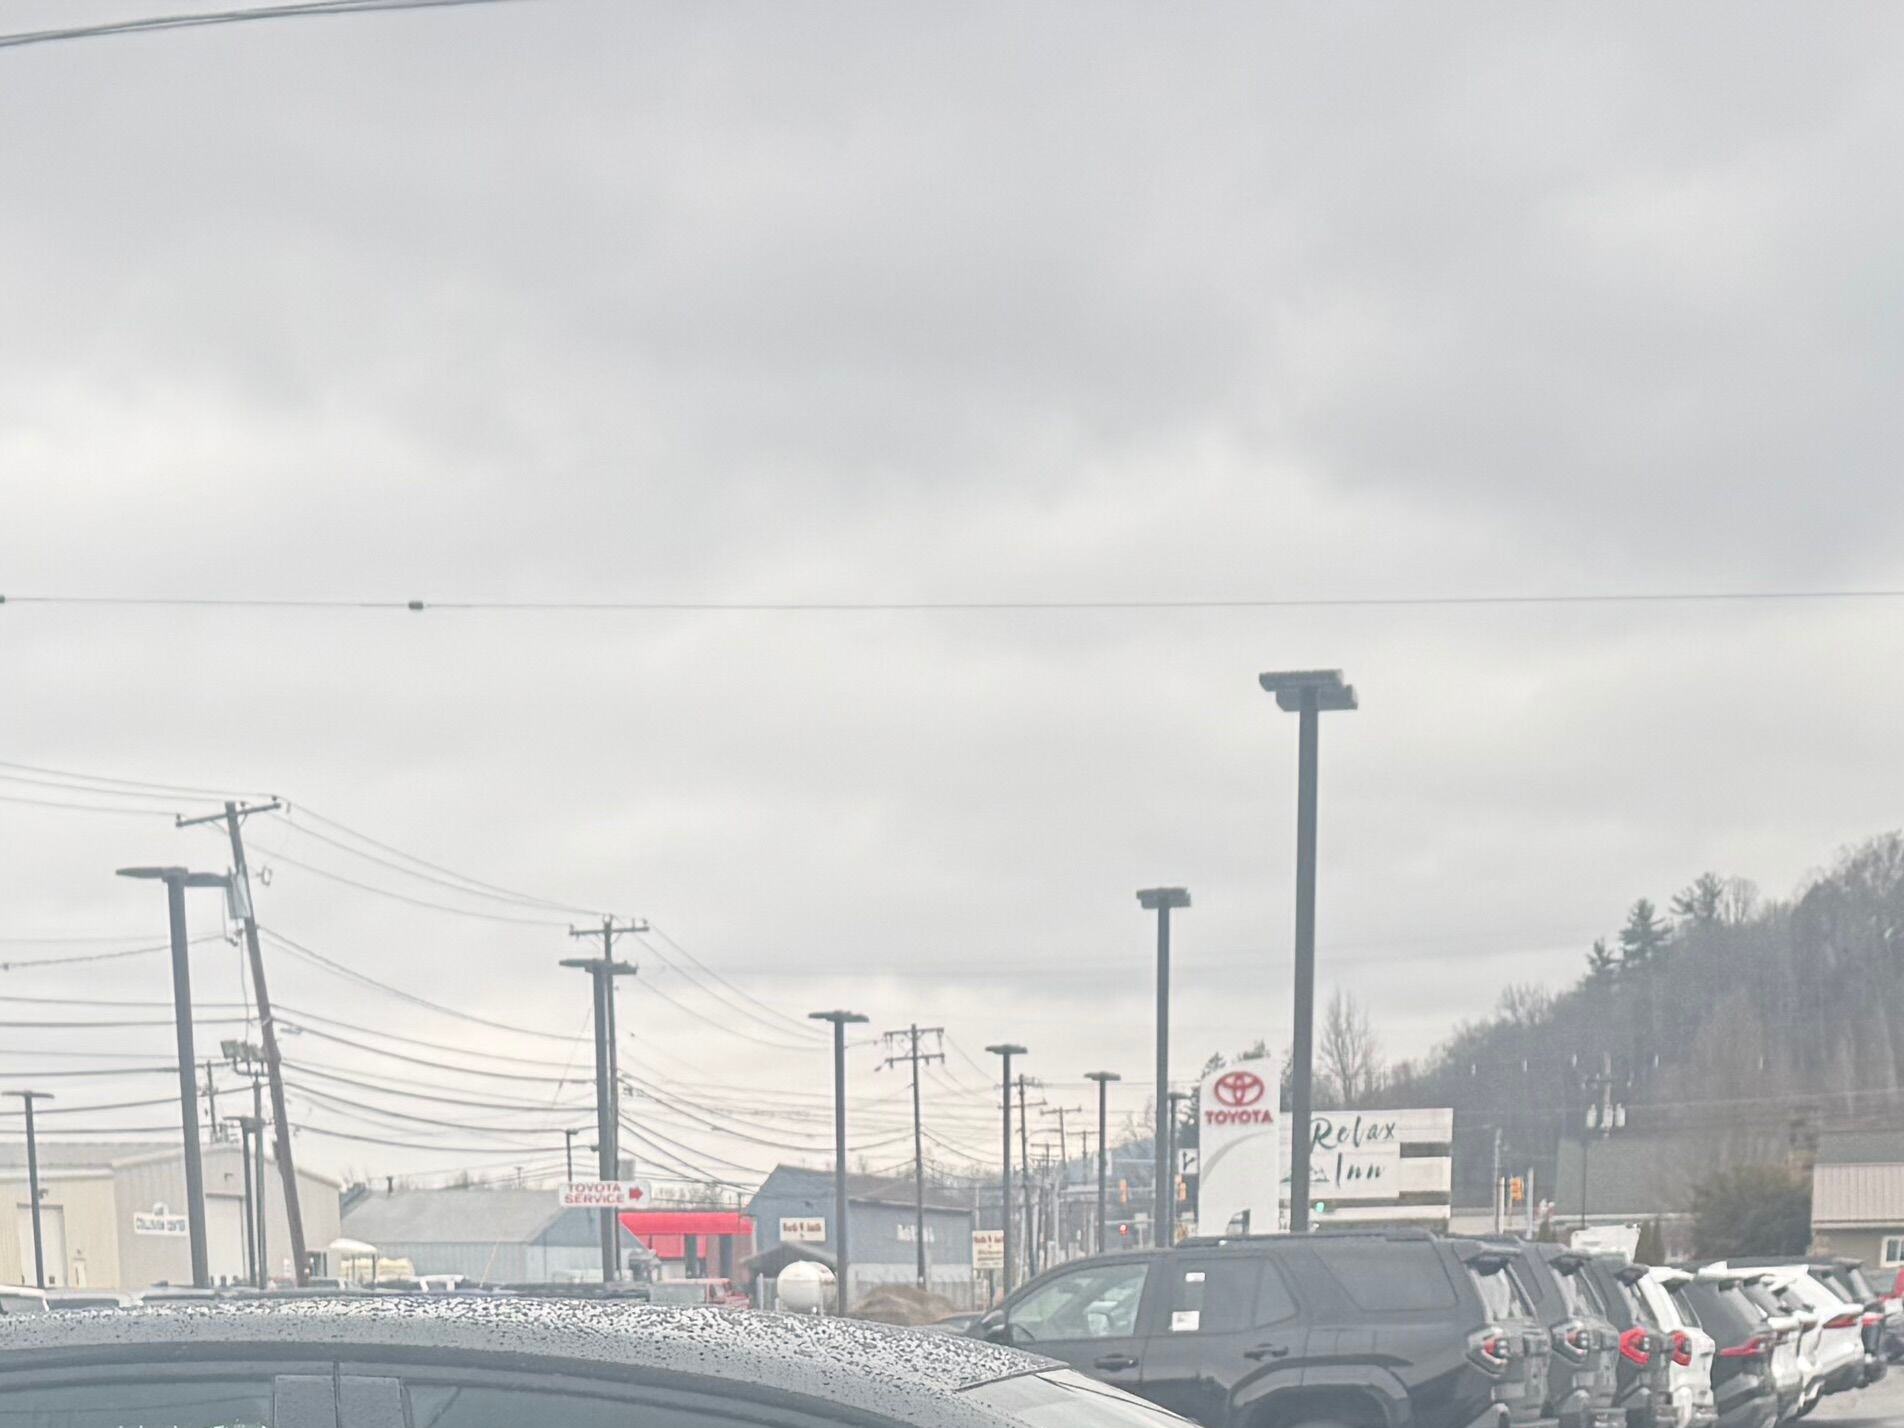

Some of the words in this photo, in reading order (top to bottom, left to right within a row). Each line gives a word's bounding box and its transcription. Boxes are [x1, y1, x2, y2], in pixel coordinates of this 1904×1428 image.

[1204, 1109, 1274, 1125] TOYOTA
[1311, 1115, 1397, 1149] Relax
[1336, 1152, 1387, 1190] Inn
[568, 1182, 622, 1193] TOYOTA
[564, 1193, 625, 1204] SERVICE
